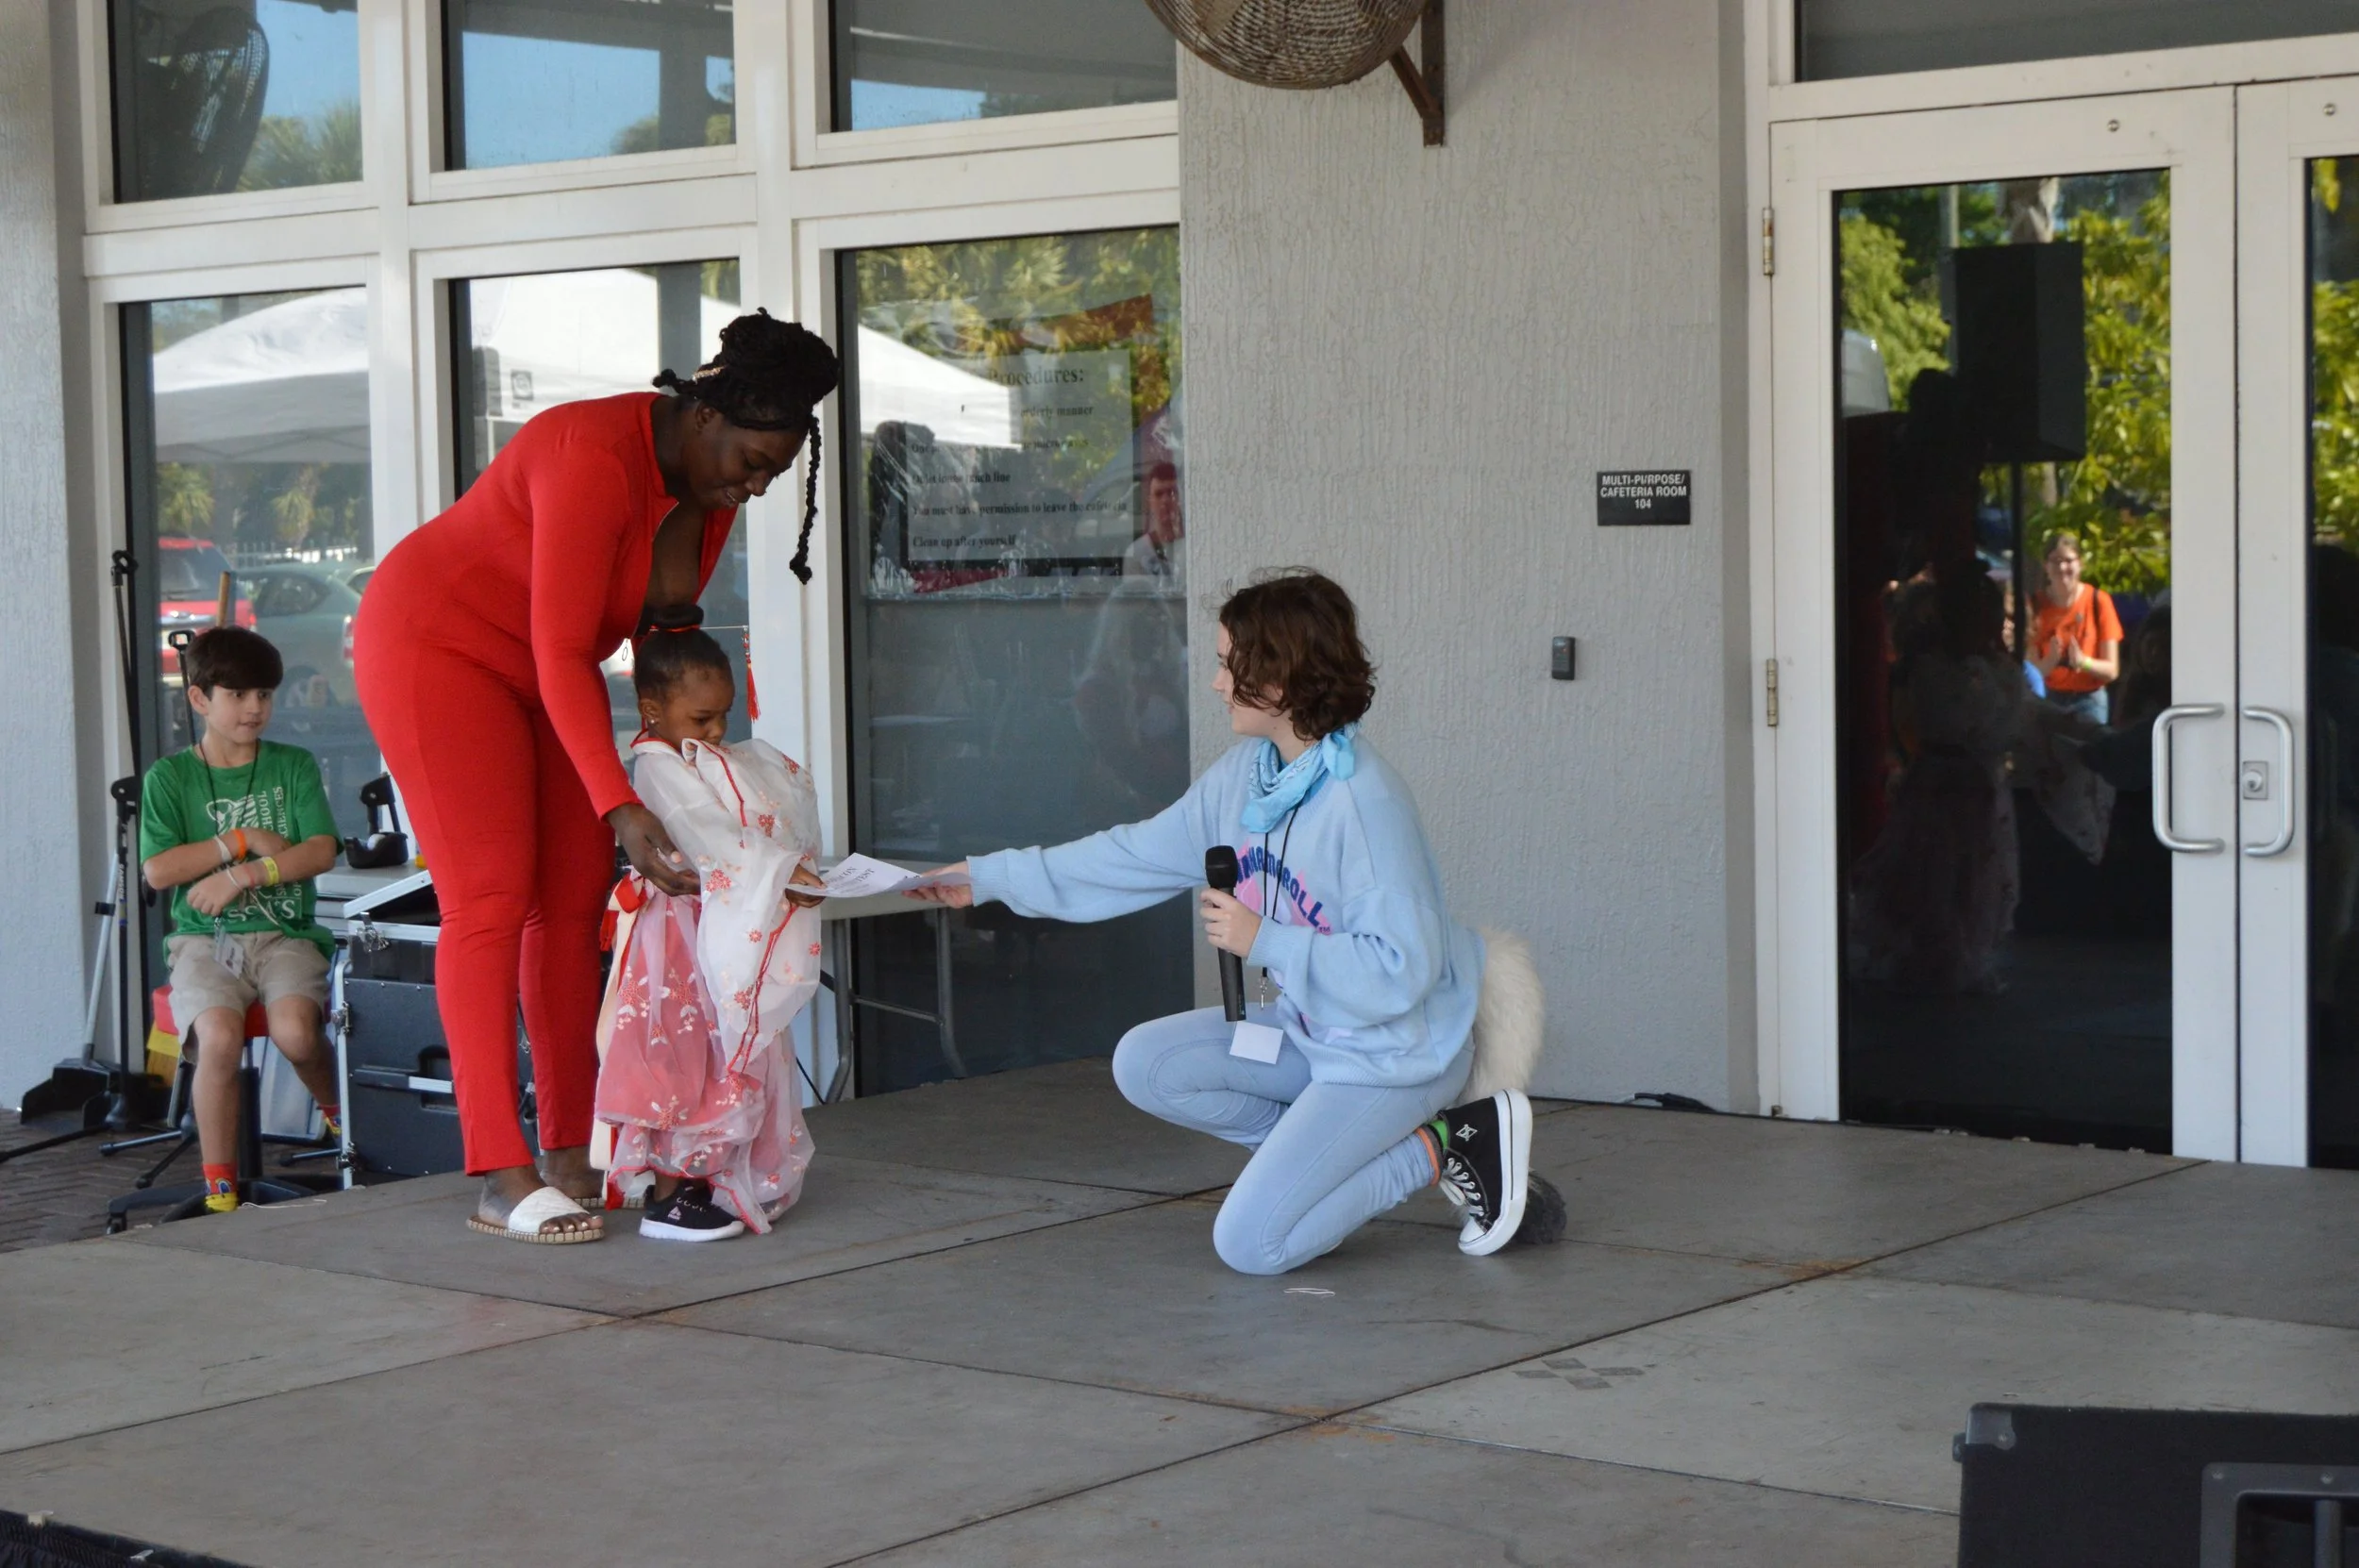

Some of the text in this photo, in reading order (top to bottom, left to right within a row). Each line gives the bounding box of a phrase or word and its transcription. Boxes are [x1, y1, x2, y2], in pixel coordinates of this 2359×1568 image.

[1057, 406, 1094, 415] manner
[994, 472, 1012, 483] line
[1602, 474, 1685, 485] MULTI-PURPOSE/
[1600, 486, 1687, 498] CAFETERIA ROOM
[979, 503, 1030, 516] permission
[1032, 503, 1041, 512] to
[1043, 502, 1066, 512] leave
[1634, 498, 1651, 509] 104
[912, 534, 1016, 549] Clean up after yourself
[257, 791, 275, 832] CHOOL
[1237, 846, 1323, 926] INNAMOROLL
